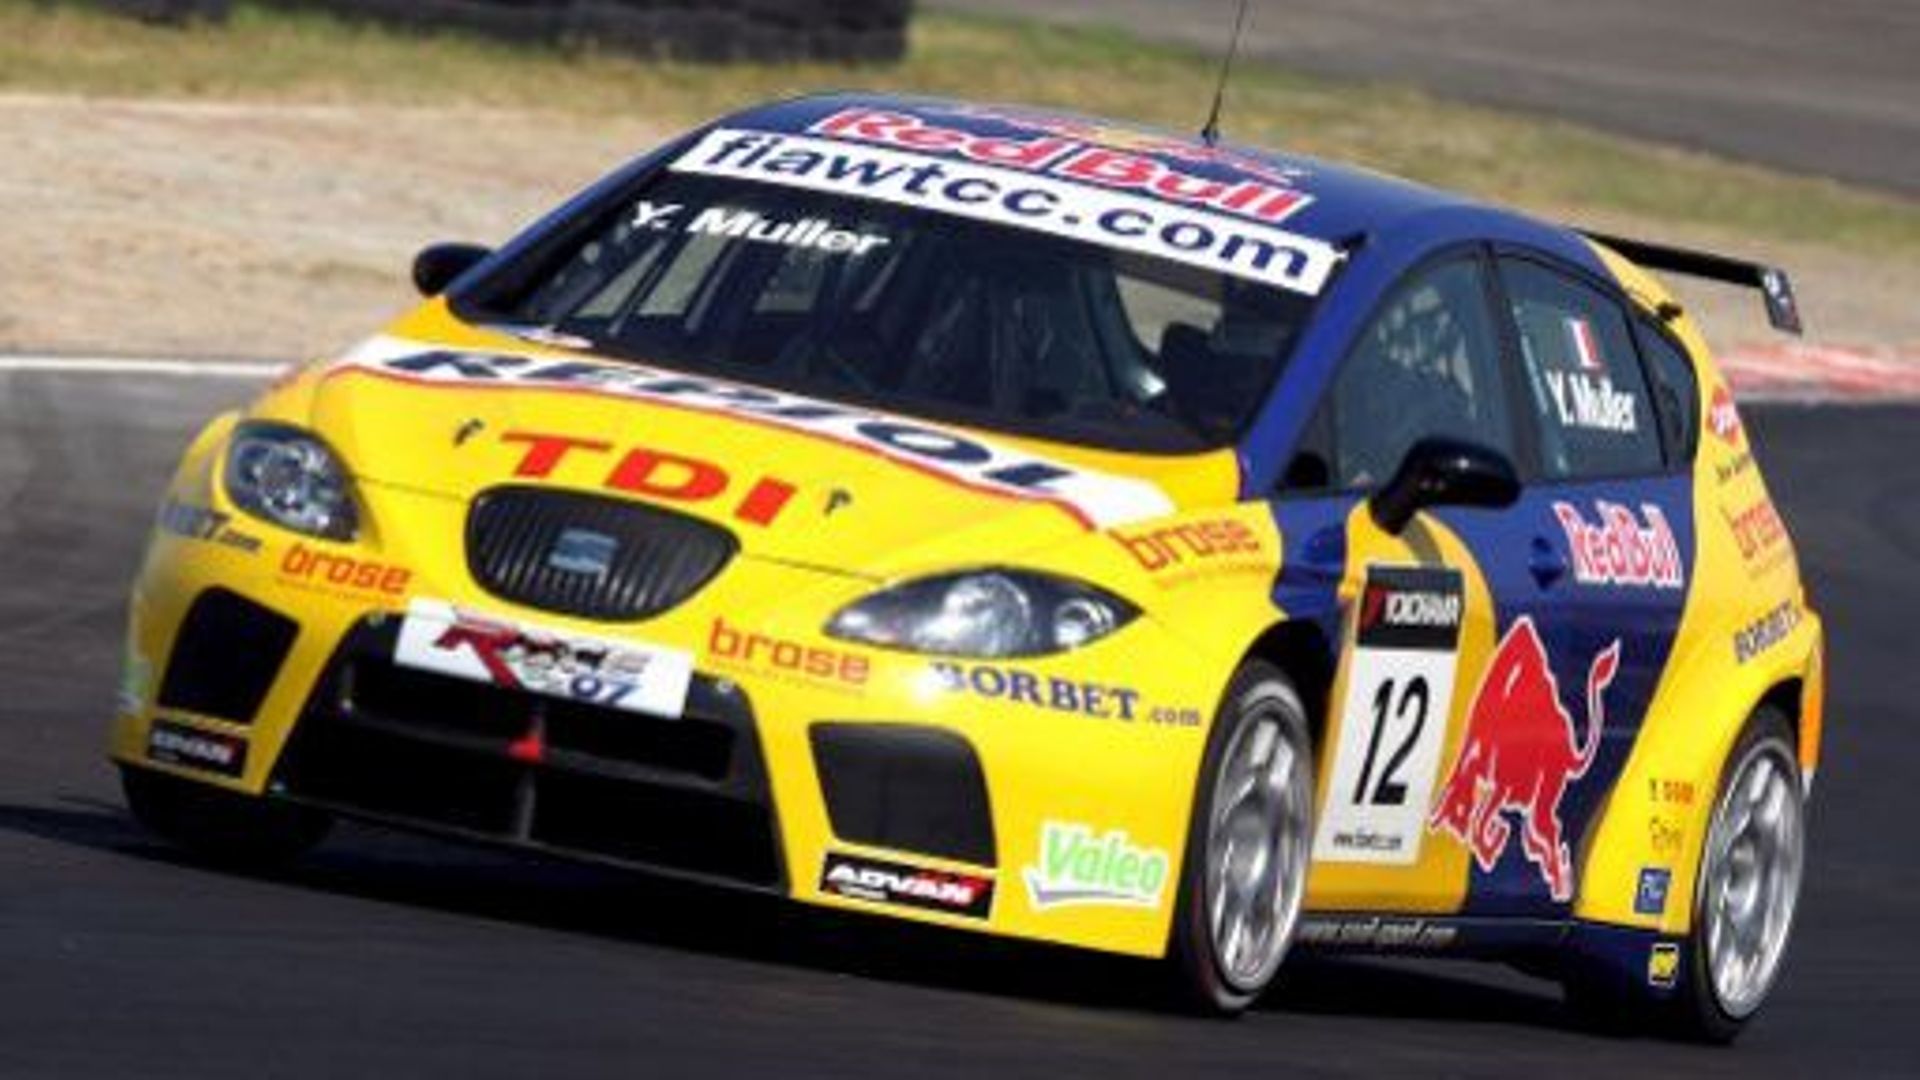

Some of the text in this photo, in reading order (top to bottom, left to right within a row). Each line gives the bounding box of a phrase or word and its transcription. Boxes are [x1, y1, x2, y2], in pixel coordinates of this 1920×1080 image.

[632, 201, 890, 255] Y. Muller
[706, 133, 1310, 281] fiawtcc.com
[1568, 373, 1637, 432] Muller
[500, 432, 797, 527] TDI
[281, 542, 412, 595] brose
[1108, 518, 1261, 571] brose
[709, 615, 869, 685] brose
[930, 660, 1140, 722] BORBET
[1351, 676, 1430, 805] 12
[826, 863, 974, 905] ADVAN
[1041, 822, 1168, 893] Valeo
